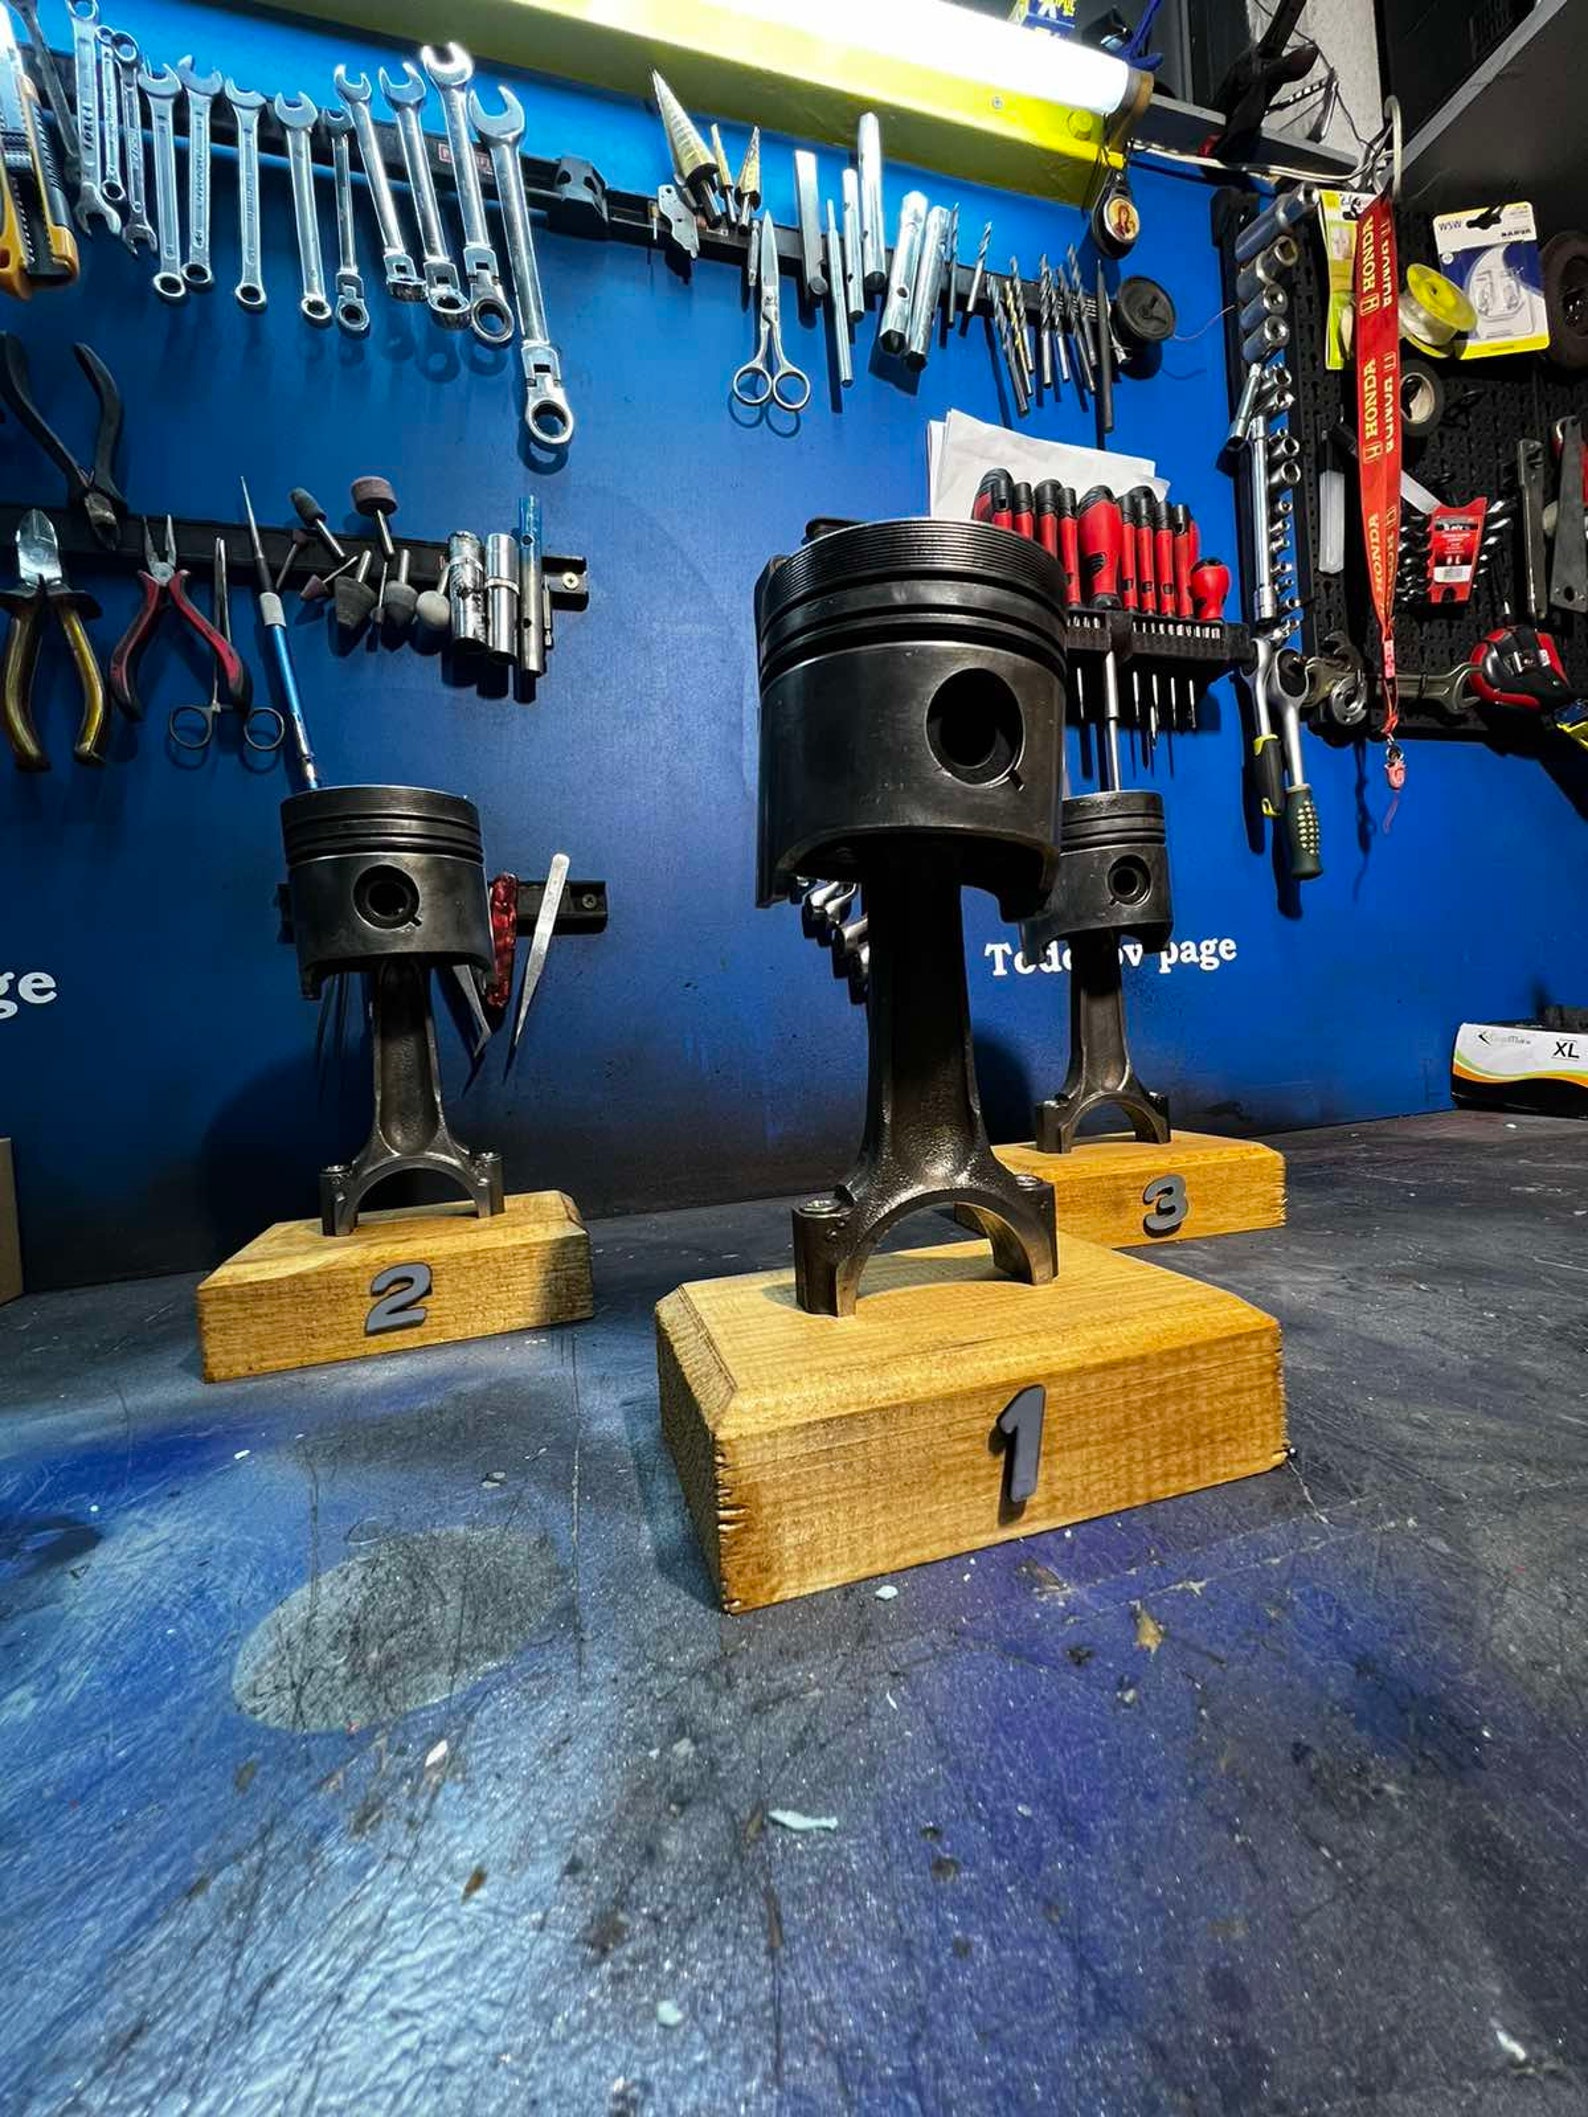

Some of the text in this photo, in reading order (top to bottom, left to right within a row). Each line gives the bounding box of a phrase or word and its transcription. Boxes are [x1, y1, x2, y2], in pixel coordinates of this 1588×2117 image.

[1362, 215, 1376, 293] HONDA
[1363, 358, 1378, 440] HONDA
[1159, 938, 1237, 974] page
[1552, 1040, 1580, 1059] XL
[1143, 1173, 1188, 1237] 3
[364, 1261, 434, 1336] 2
[995, 1384, 1047, 1510] 1
